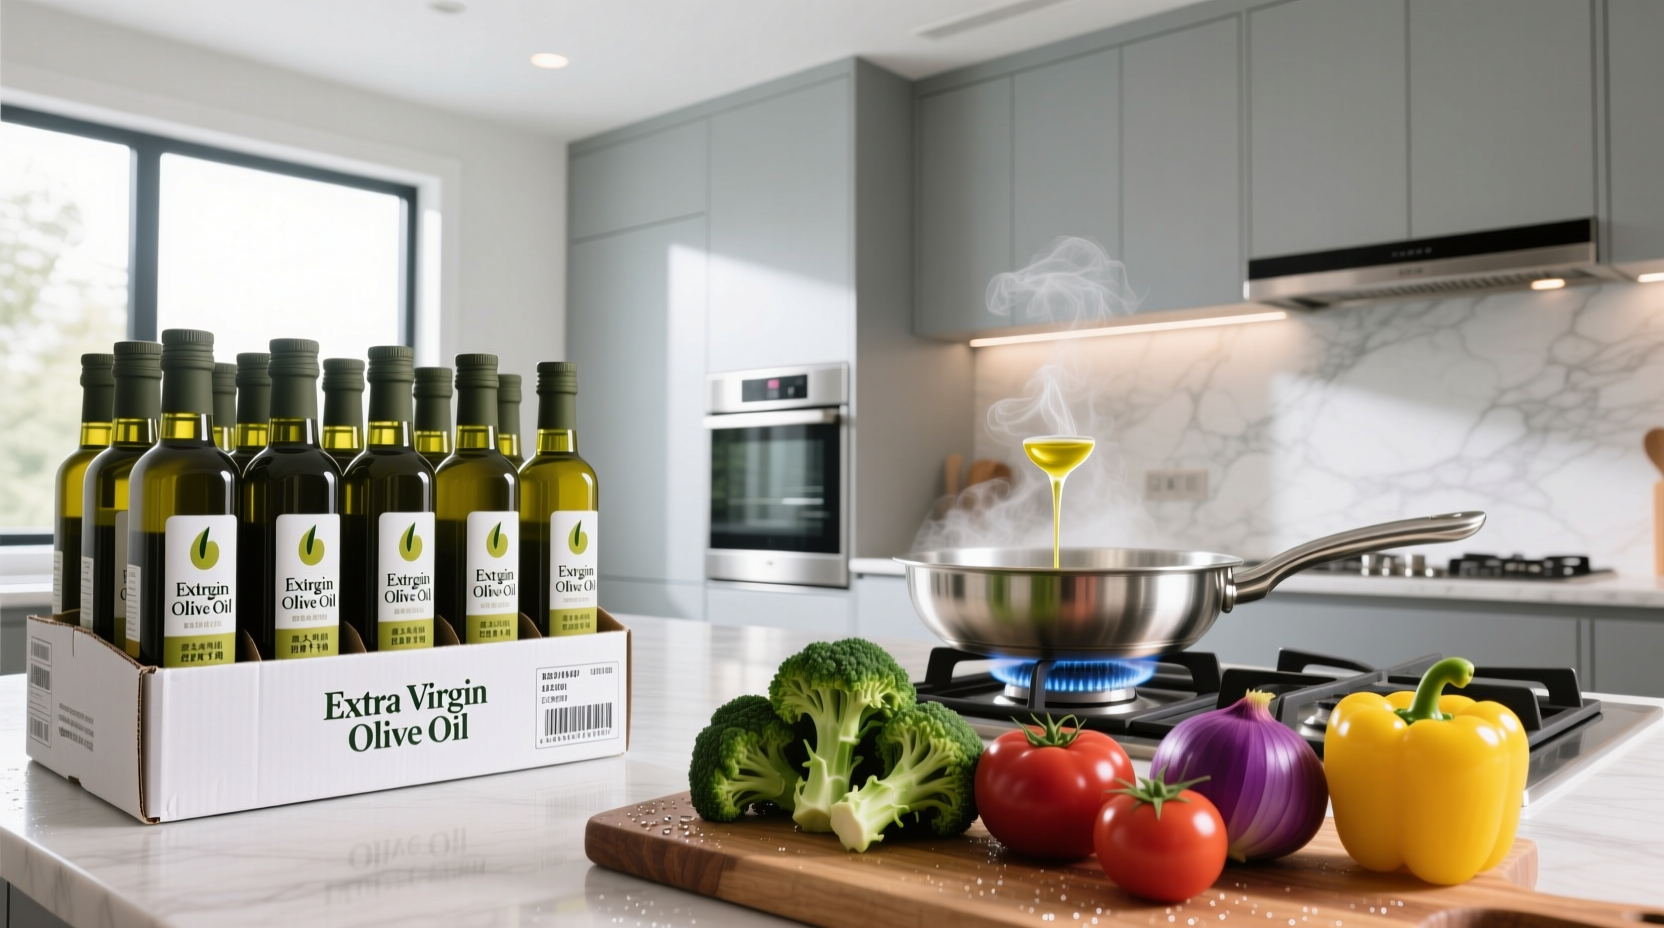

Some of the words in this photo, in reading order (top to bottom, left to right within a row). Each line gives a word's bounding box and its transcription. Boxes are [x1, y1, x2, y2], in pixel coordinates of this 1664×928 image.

[171, 600, 210, 616] Olive
[212, 598, 232, 615] Oil
[281, 594, 317, 610] Olive
[319, 593, 336, 608] Oil
[323, 690, 401, 721] Extra
[406, 678, 488, 714] Virgin
[348, 719, 423, 753] Olive
[428, 712, 469, 743] Oil
